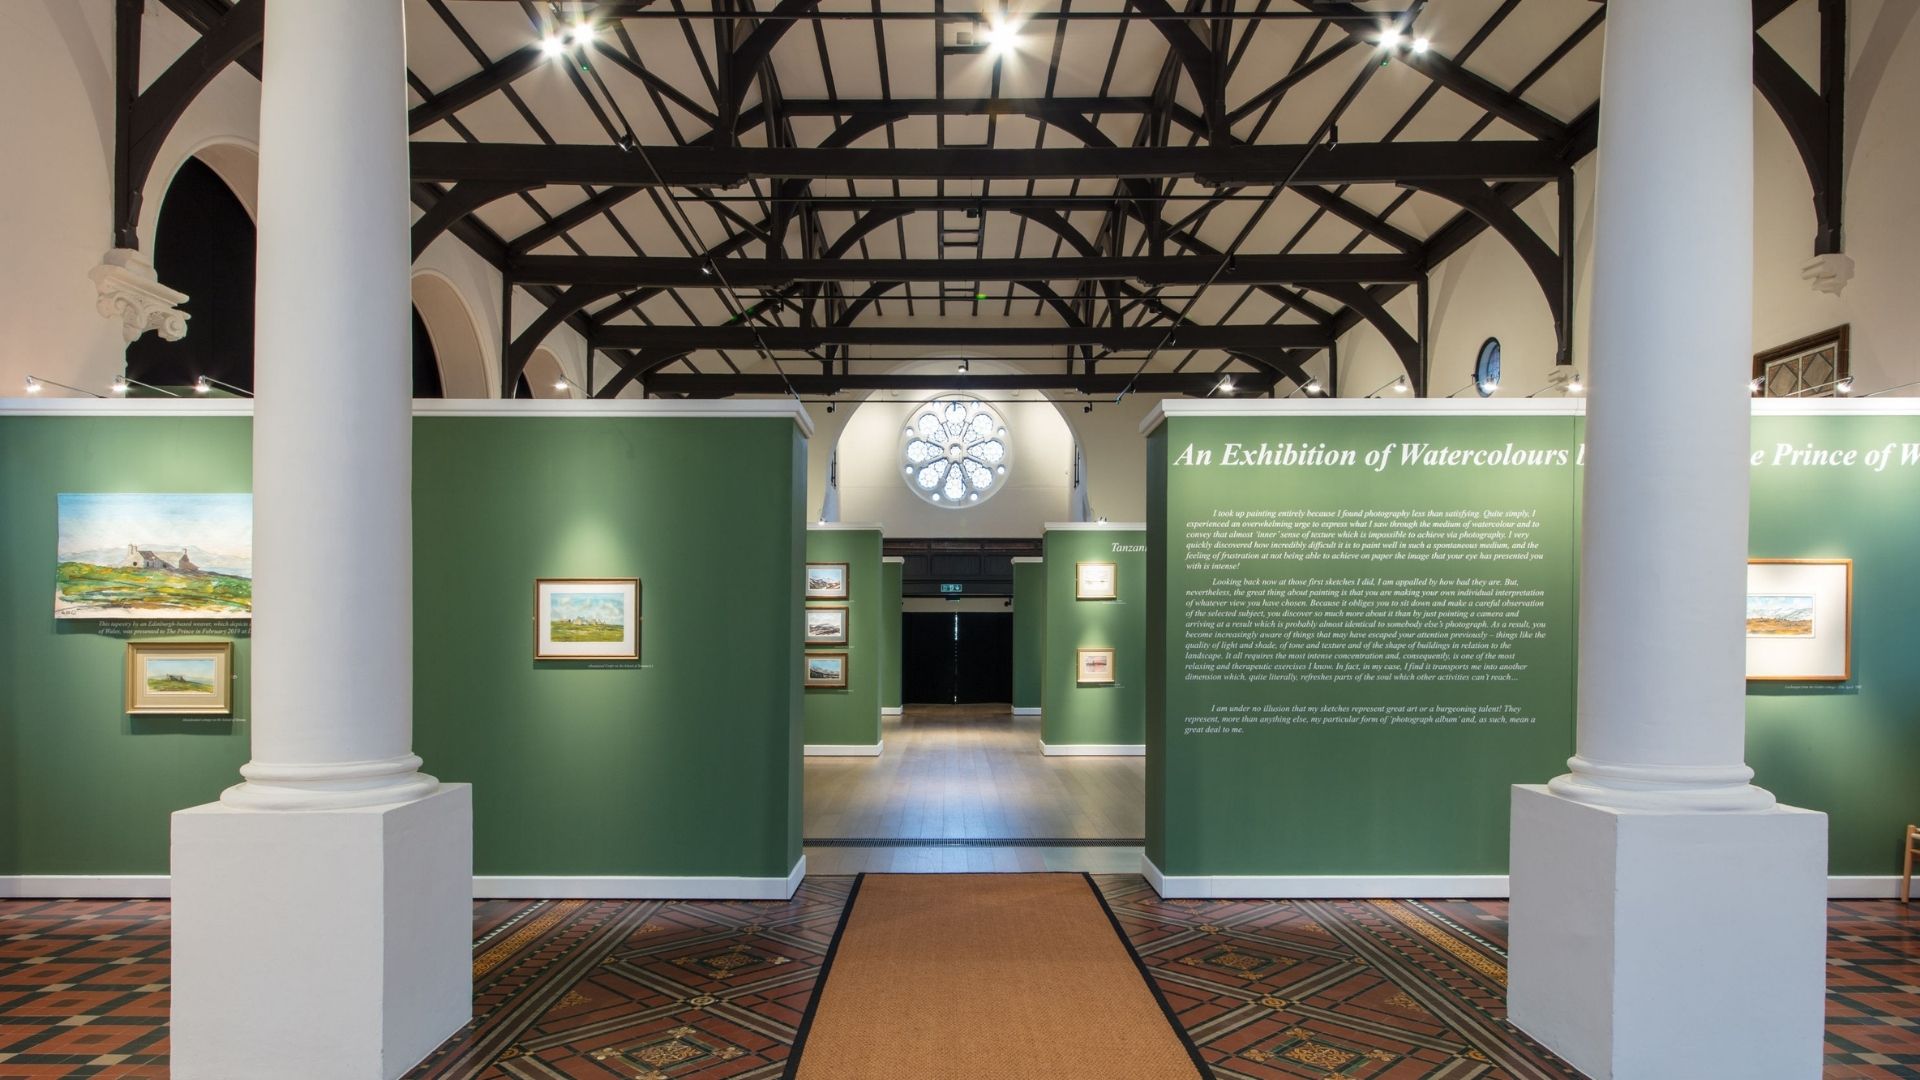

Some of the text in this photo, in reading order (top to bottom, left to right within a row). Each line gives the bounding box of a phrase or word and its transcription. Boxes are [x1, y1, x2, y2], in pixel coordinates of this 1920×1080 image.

[1173, 443, 1212, 466] An
[1219, 442, 1356, 466] Exhibition
[1364, 442, 1396, 472] of
[1399, 443, 1569, 467] Watercolours
[1771, 443, 1858, 466] Prince
[1864, 443, 1897, 472] of
[1246, 510, 1277, 518] painting
[1277, 510, 1305, 518] entirely
[1342, 510, 1363, 518] found
[1363, 510, 1410, 519] photography
[1483, 510, 1504, 518] Quite
[1186, 520, 1230, 529] experienced
[1242, 520, 1293, 529] overwhelming
[1389, 520, 1418, 529] through
[1462, 520, 1471, 529] of
[1301, 531, 1311, 540] of
[1368, 531, 1407, 540] impossible
[1186, 541, 1213, 550] quickly
[1270, 542, 1307, 550] incredibly
[1308, 542, 1337, 550] difficult
[1361, 542, 1381, 550] paint
[1186, 552, 1211, 560] feeling
[1212, 552, 1221, 561] of
[1221, 552, 1260, 560] frustration
[1283, 552, 1304, 561] being
[1407, 553, 1430, 561] image
[1493, 552, 1529, 561] presented
[1267, 589, 1286, 597] thing
[1309, 589, 1340, 597] painting
[1393, 589, 1420, 597] making
[1495, 589, 1545, 598] interpretation
[1351, 706, 1385, 714] represent
[1386, 706, 1406, 714] great
[1435, 705, 1477, 714] burgeoning
[1503, 705, 1522, 714] They
